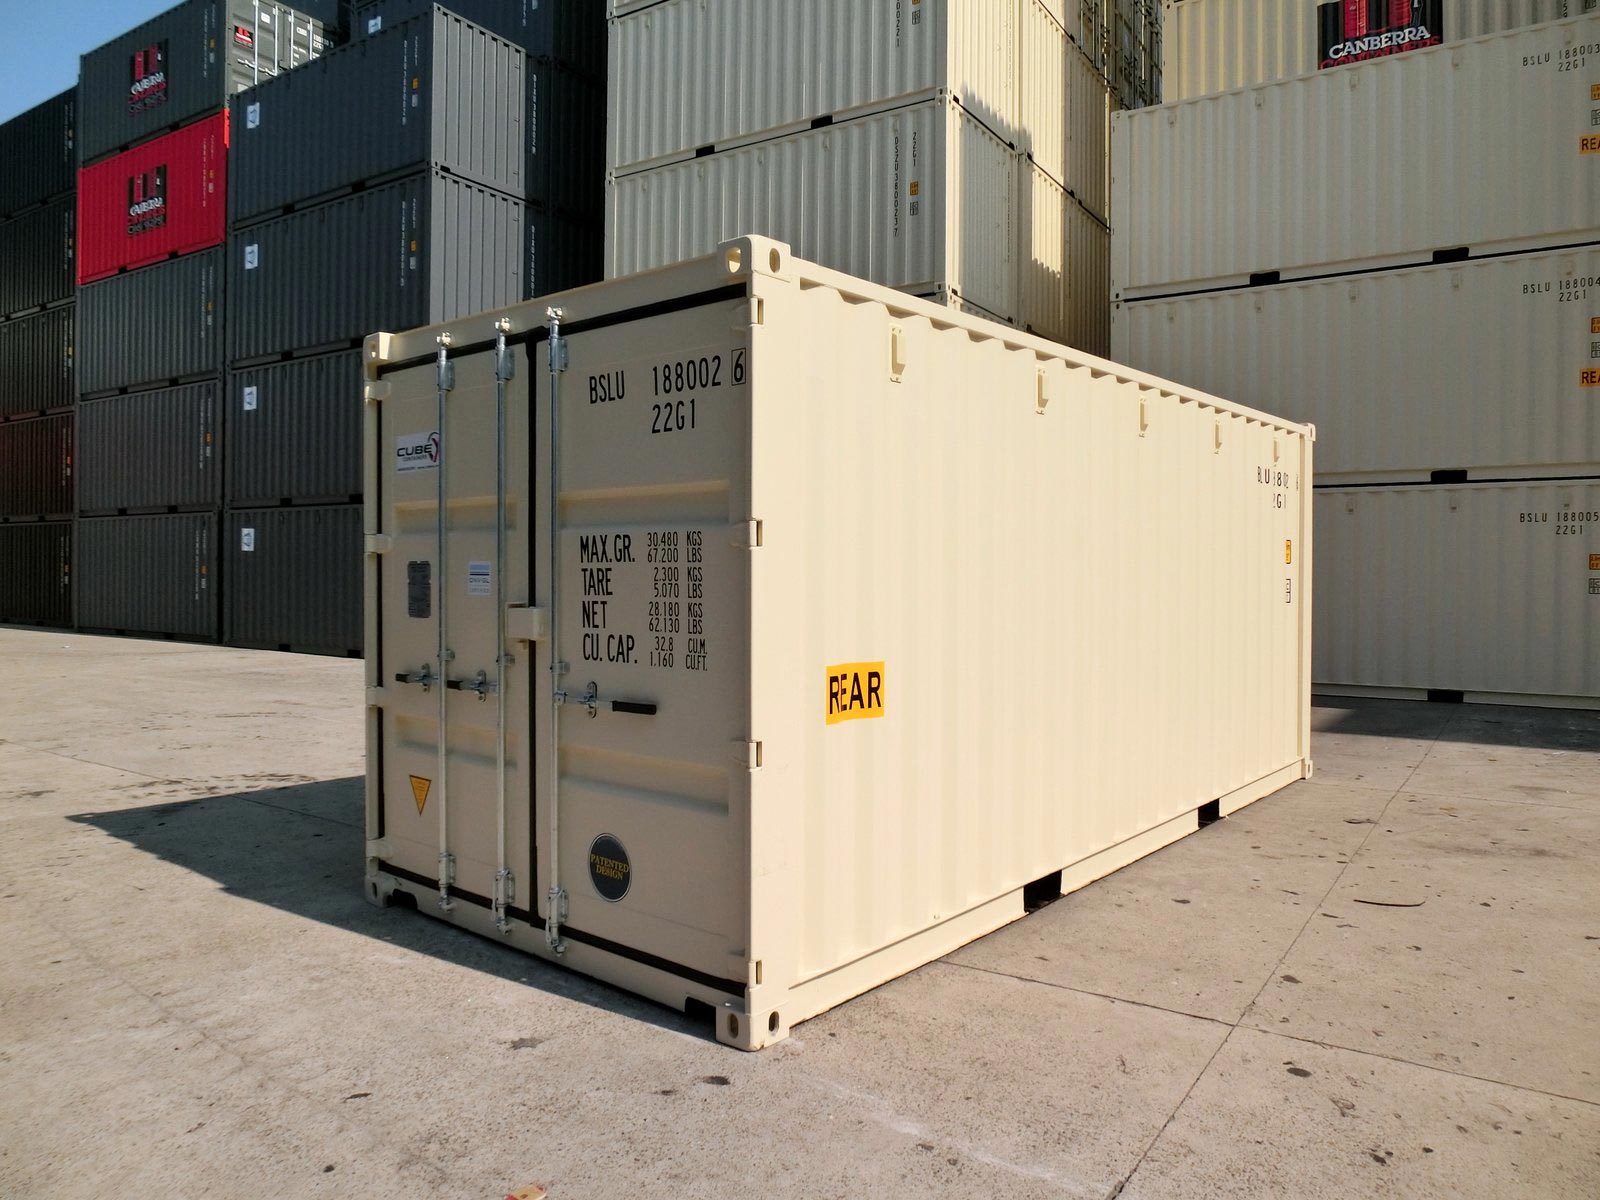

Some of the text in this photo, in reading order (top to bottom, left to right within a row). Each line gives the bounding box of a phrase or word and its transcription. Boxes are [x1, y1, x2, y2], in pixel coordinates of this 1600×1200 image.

[1329, 25, 1430, 59] CANBERRA
[1522, 52, 1550, 66] BSLU
[1558, 58, 1585, 72] 22G1
[1523, 282, 1550, 294] BSLU
[1559, 290, 1586, 302] 22G1
[589, 351, 744, 404] BSLU 188002 6
[652, 399, 695, 434] 22G1
[397, 444, 432, 457] CUBE
[1520, 512, 1599, 522] BSLU 188005
[1556, 525, 1583, 535] 22G1
[647, 532, 678, 547] 30.480
[687, 531, 702, 546] KGS
[647, 548, 702, 563] 67.200 LBS
[581, 567, 702, 596] TARE 2.300 KGS
[654, 583, 702, 598] 5.070 LBS
[582, 601, 702, 628] NET 28.180 KGS
[649, 618, 702, 634] 62.130 LBS
[655, 636, 674, 652] 32.8
[650, 652, 674, 668] 1.160
[830, 671, 881, 714] REAR
[590, 854, 630, 873] PATENTED
[596, 865, 624, 880] DESIGN
